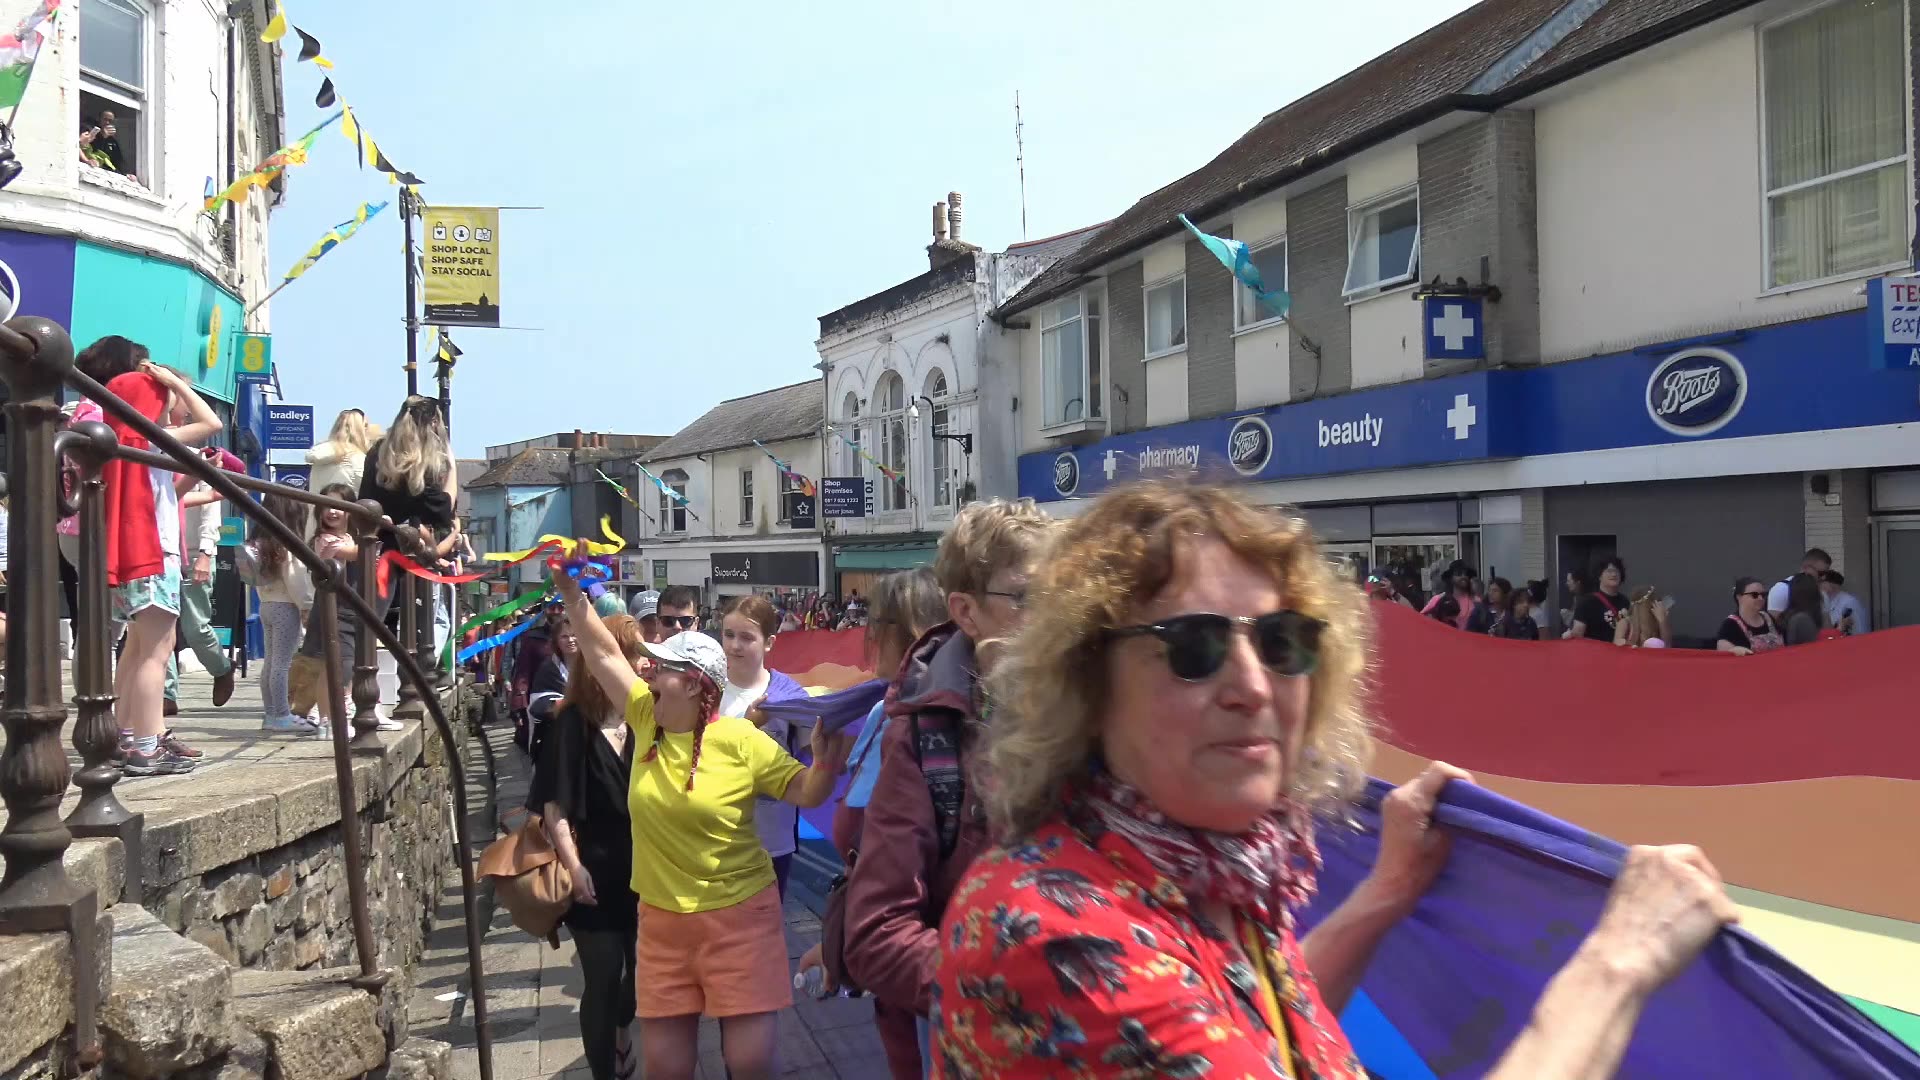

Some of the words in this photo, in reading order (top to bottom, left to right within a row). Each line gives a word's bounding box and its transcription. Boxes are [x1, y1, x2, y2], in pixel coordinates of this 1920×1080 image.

[432, 245, 458, 253] SHOP
[432, 256, 458, 264] SHOP
[460, 257, 484, 265] SAFE
[432, 266, 455, 275] STAY
[456, 267, 492, 276] SOCIAL
[1890, 284, 1920, 302] TE
[1656, 365, 1721, 415] Boots
[270, 411, 310, 422] bradleys
[1318, 413, 1383, 448] beauty
[1232, 430, 1260, 461] Boots
[1139, 444, 1200, 472] pharmacy
[865, 480, 873, 493] TO
[865, 497, 873, 515] LET
[714, 566, 748, 580] Superdrug
